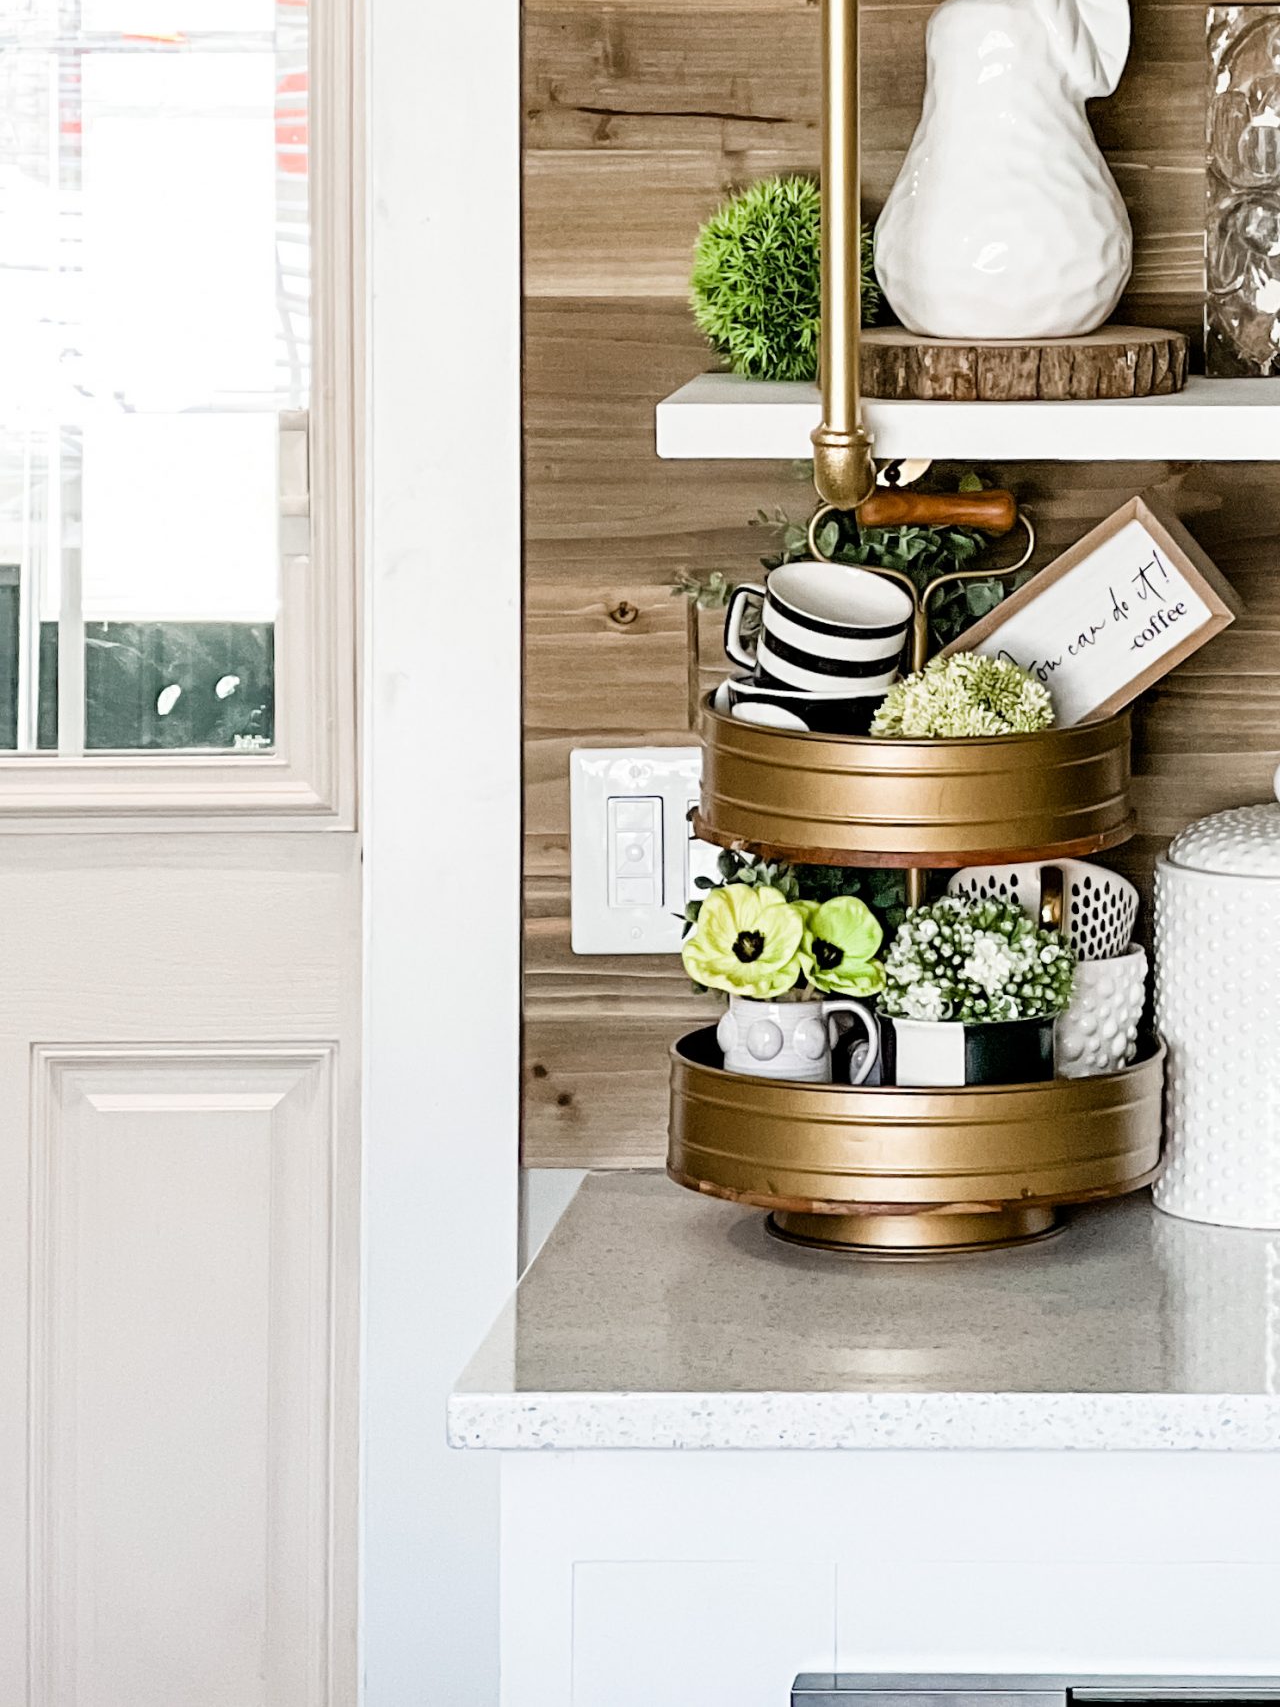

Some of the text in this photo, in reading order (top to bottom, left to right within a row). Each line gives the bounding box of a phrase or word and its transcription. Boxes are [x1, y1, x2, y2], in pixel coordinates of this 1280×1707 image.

[1068, 618, 1106, 655] can
[1109, 586, 1130, 621] do
[1131, 550, 1171, 603] it!
